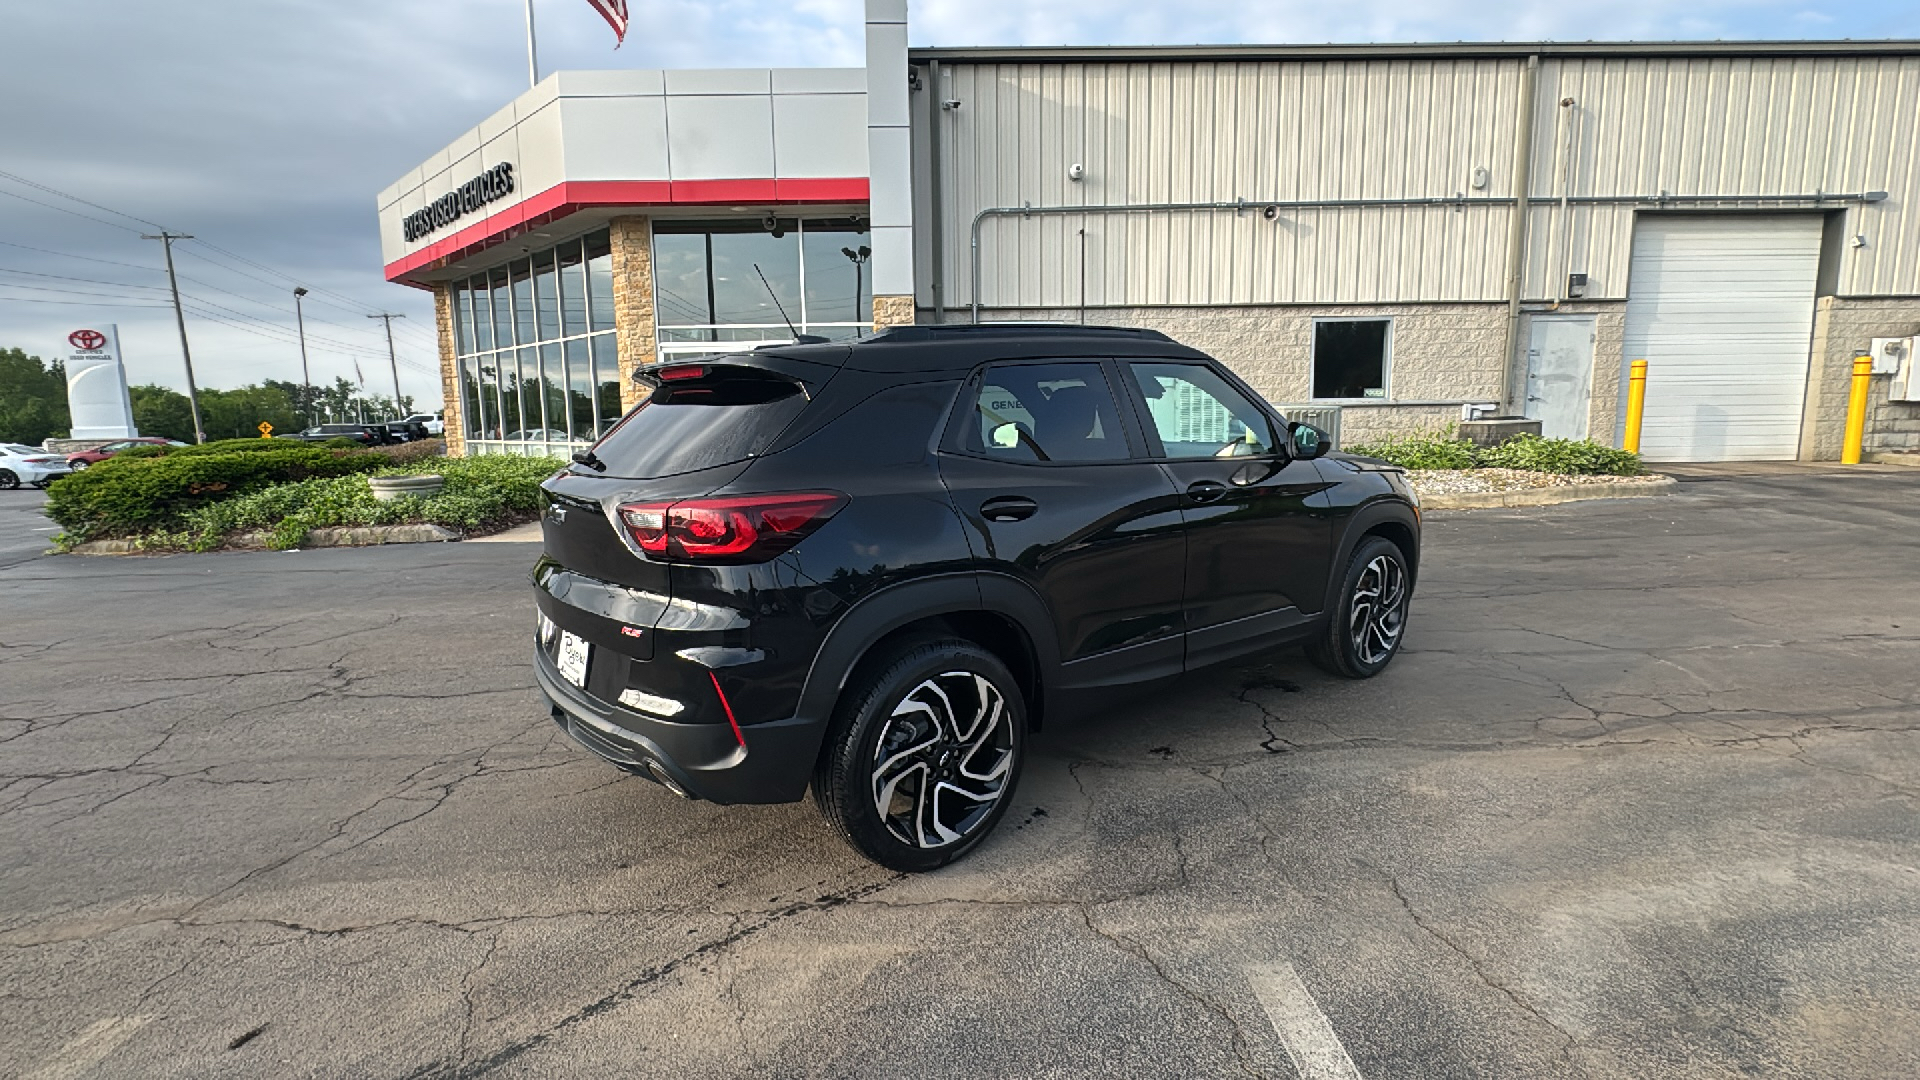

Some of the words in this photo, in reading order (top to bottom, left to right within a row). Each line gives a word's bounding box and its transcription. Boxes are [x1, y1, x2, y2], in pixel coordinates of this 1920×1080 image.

[403, 206, 433, 242] BYERS
[431, 192, 461, 228] USED
[457, 162, 515, 214] VEHICLES
[621, 626, 643, 639] RS
